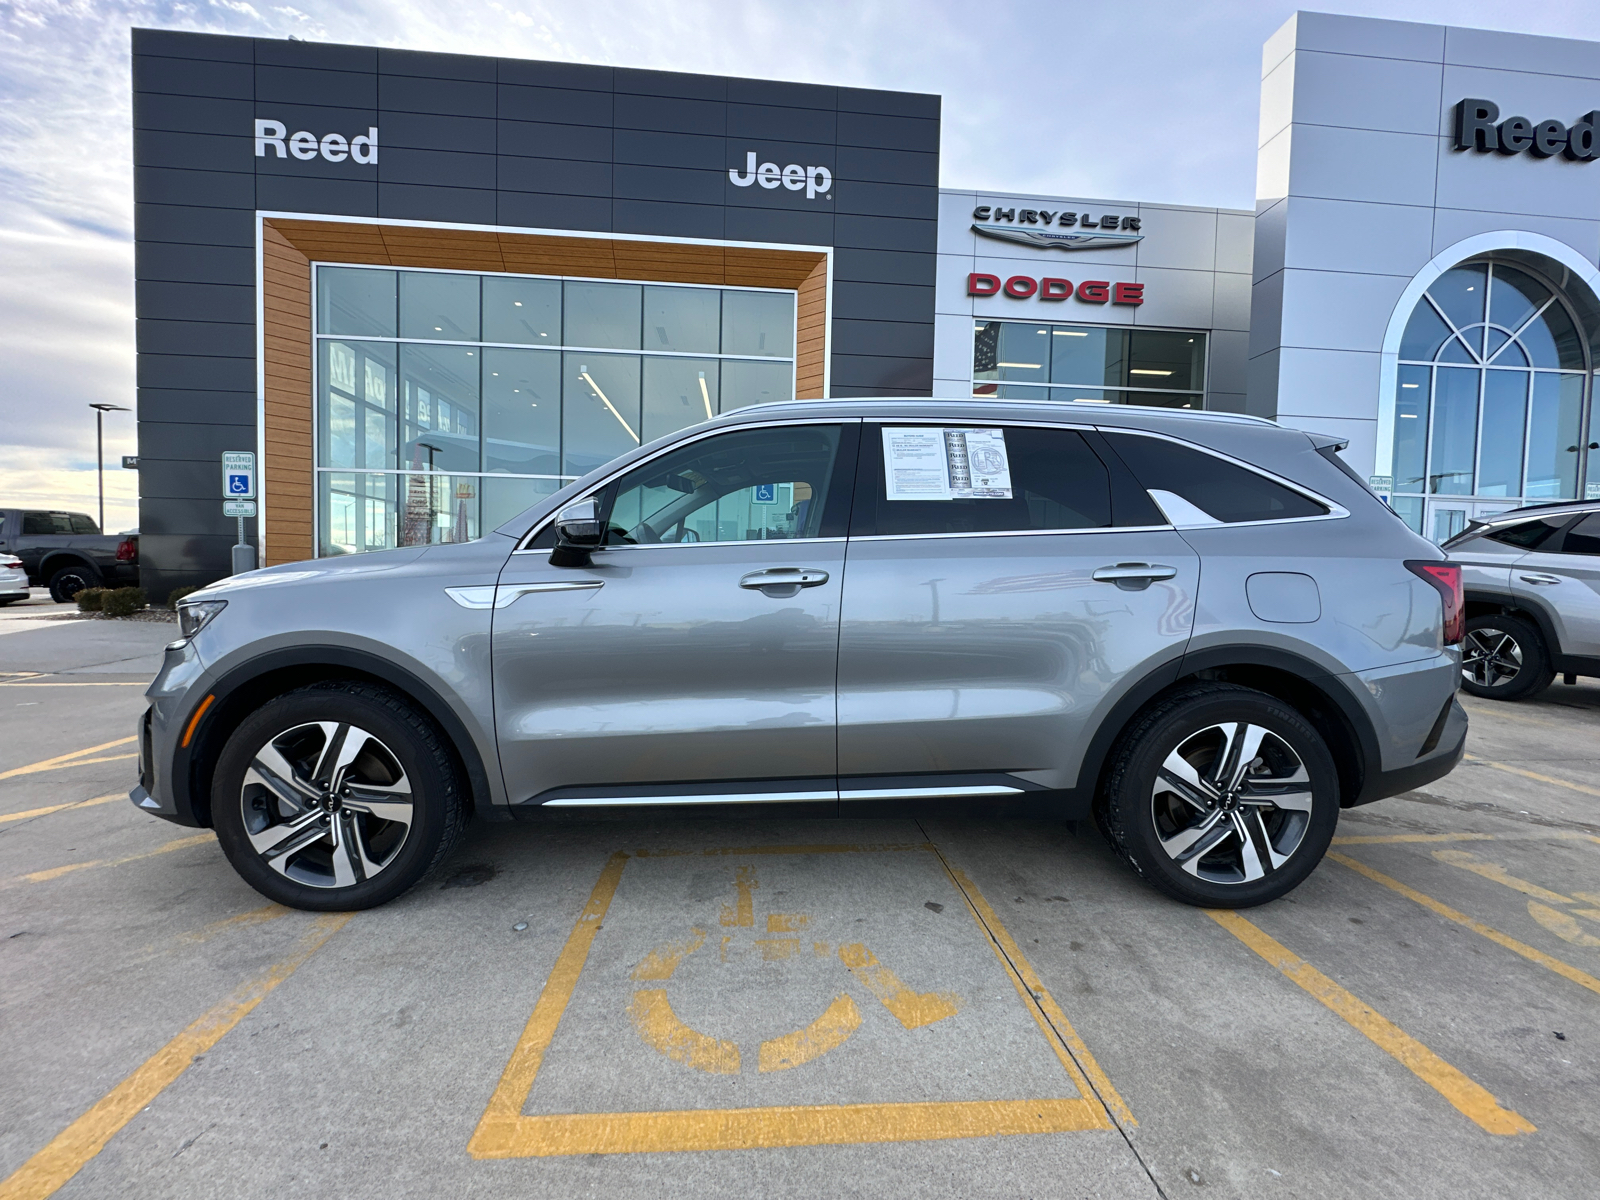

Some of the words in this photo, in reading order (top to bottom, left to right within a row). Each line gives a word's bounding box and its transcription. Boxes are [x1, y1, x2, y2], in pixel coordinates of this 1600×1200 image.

[255, 118, 378, 165] Reed
[1454, 98, 1600, 160] Reed
[729, 151, 832, 199] Jeep
[973, 206, 1142, 229] CHRYSLER
[967, 272, 1145, 306] DODGE
[226, 463, 252, 471] PARKING
[1267, 706, 1316, 743] FINALIST
